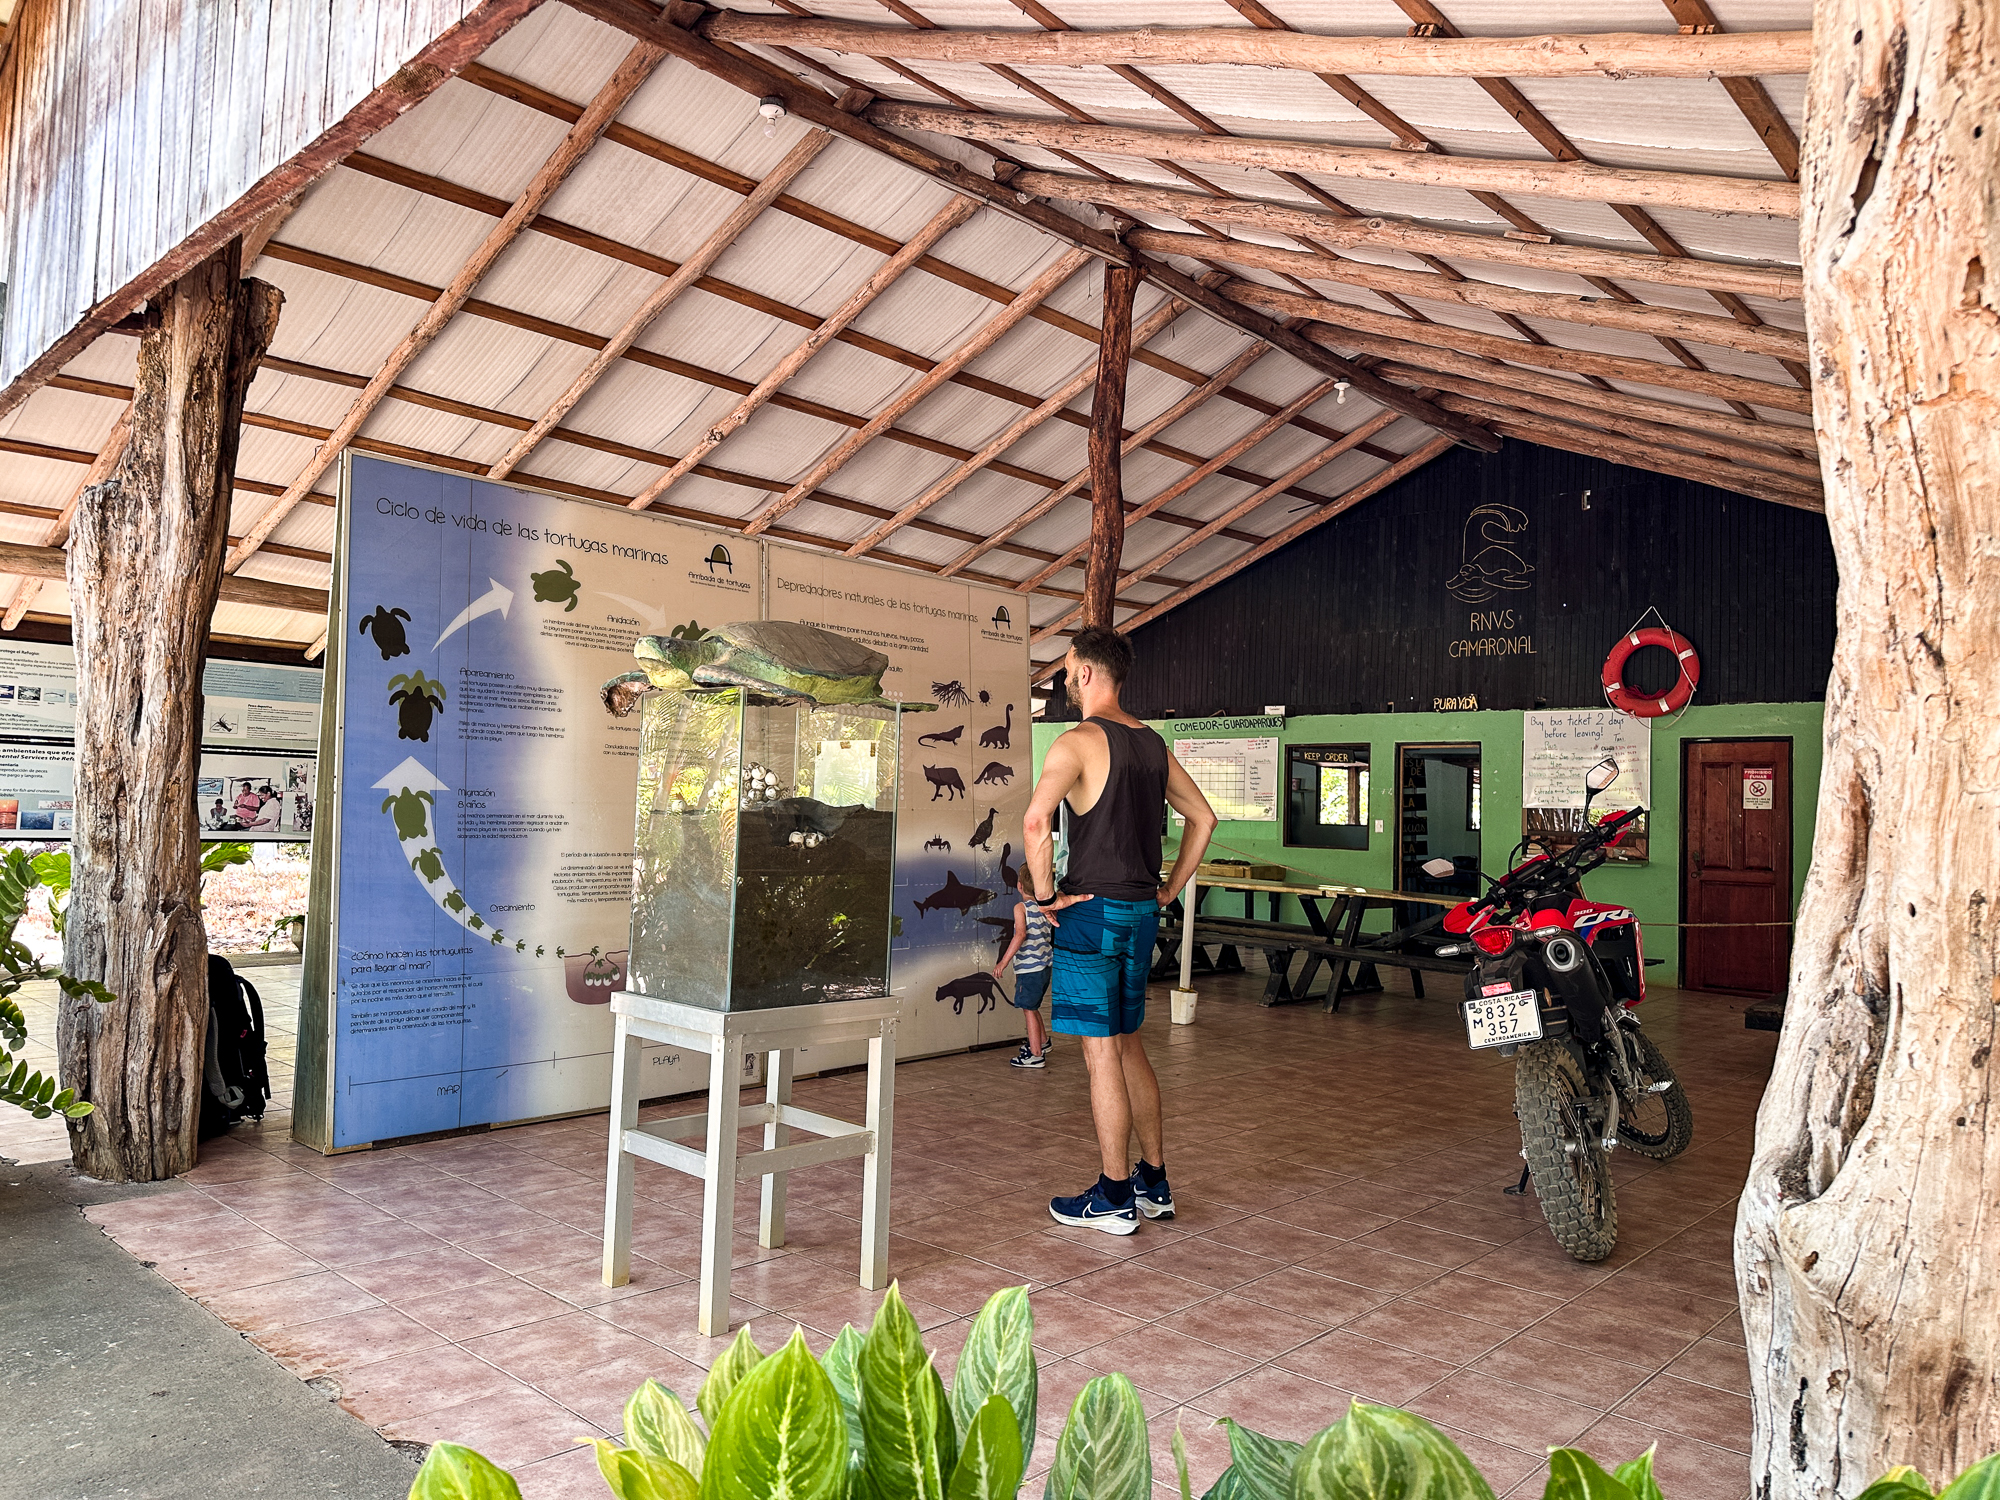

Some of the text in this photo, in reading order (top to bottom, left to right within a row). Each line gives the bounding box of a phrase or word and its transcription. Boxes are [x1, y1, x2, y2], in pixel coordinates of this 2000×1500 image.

[376, 497, 669, 565] Ciclo de vida de las tortugas marinas
[688, 571, 716, 583] Arribada
[726, 579, 751, 589] tortugas
[777, 577, 979, 624] Depredadores naturales de las tortugas marinas
[606, 614, 641, 626] Anidación
[1470, 608, 1515, 632] RNVS
[799, 618, 821, 628] Aunque
[826, 622, 846, 632] hembra
[846, 626, 860, 634] pone
[860, 628, 880, 637] muchos
[899, 633, 910, 642] muy
[854, 636, 872, 645] adultos
[872, 638, 888, 648] debido
[910, 644, 929, 653] cantidad
[1448, 635, 1538, 658] CAMARONAL
[459, 667, 515, 681] Apareamiento
[468, 678, 488, 688] tortugas
[1433, 697, 1457, 710] PURA
[1174, 716, 1283, 732] COMEDOR-GUARDAPARQUES
[1530, 712, 1625, 732] Buy bus ticket 2 days
[1544, 726, 1604, 741] before leaving!
[1304, 751, 1349, 762] KEEP ORDER
[1410, 767, 1422, 776] DE
[457, 787, 496, 797] Migración
[457, 799, 486, 809] 8 años
[1402, 844, 1415, 854] LA
[489, 903, 536, 913] Crecimiento
[350, 946, 474, 961] ¿Cómo hacen las tortuguitas
[350, 960, 432, 976] para llegar al mar?
[1478, 998, 1502, 1007] COSTA
[388, 1009, 416, 1017] propuesto
[1485, 1002, 1518, 1020] 832
[402, 1021, 430, 1029] orientación
[1473, 1018, 1484, 1029] M
[1487, 1018, 1518, 1036] 357
[1484, 1032, 1532, 1044] CENTROAMERICA
[652, 1054, 680, 1066] PLAYA
[436, 1084, 461, 1097] MAR
